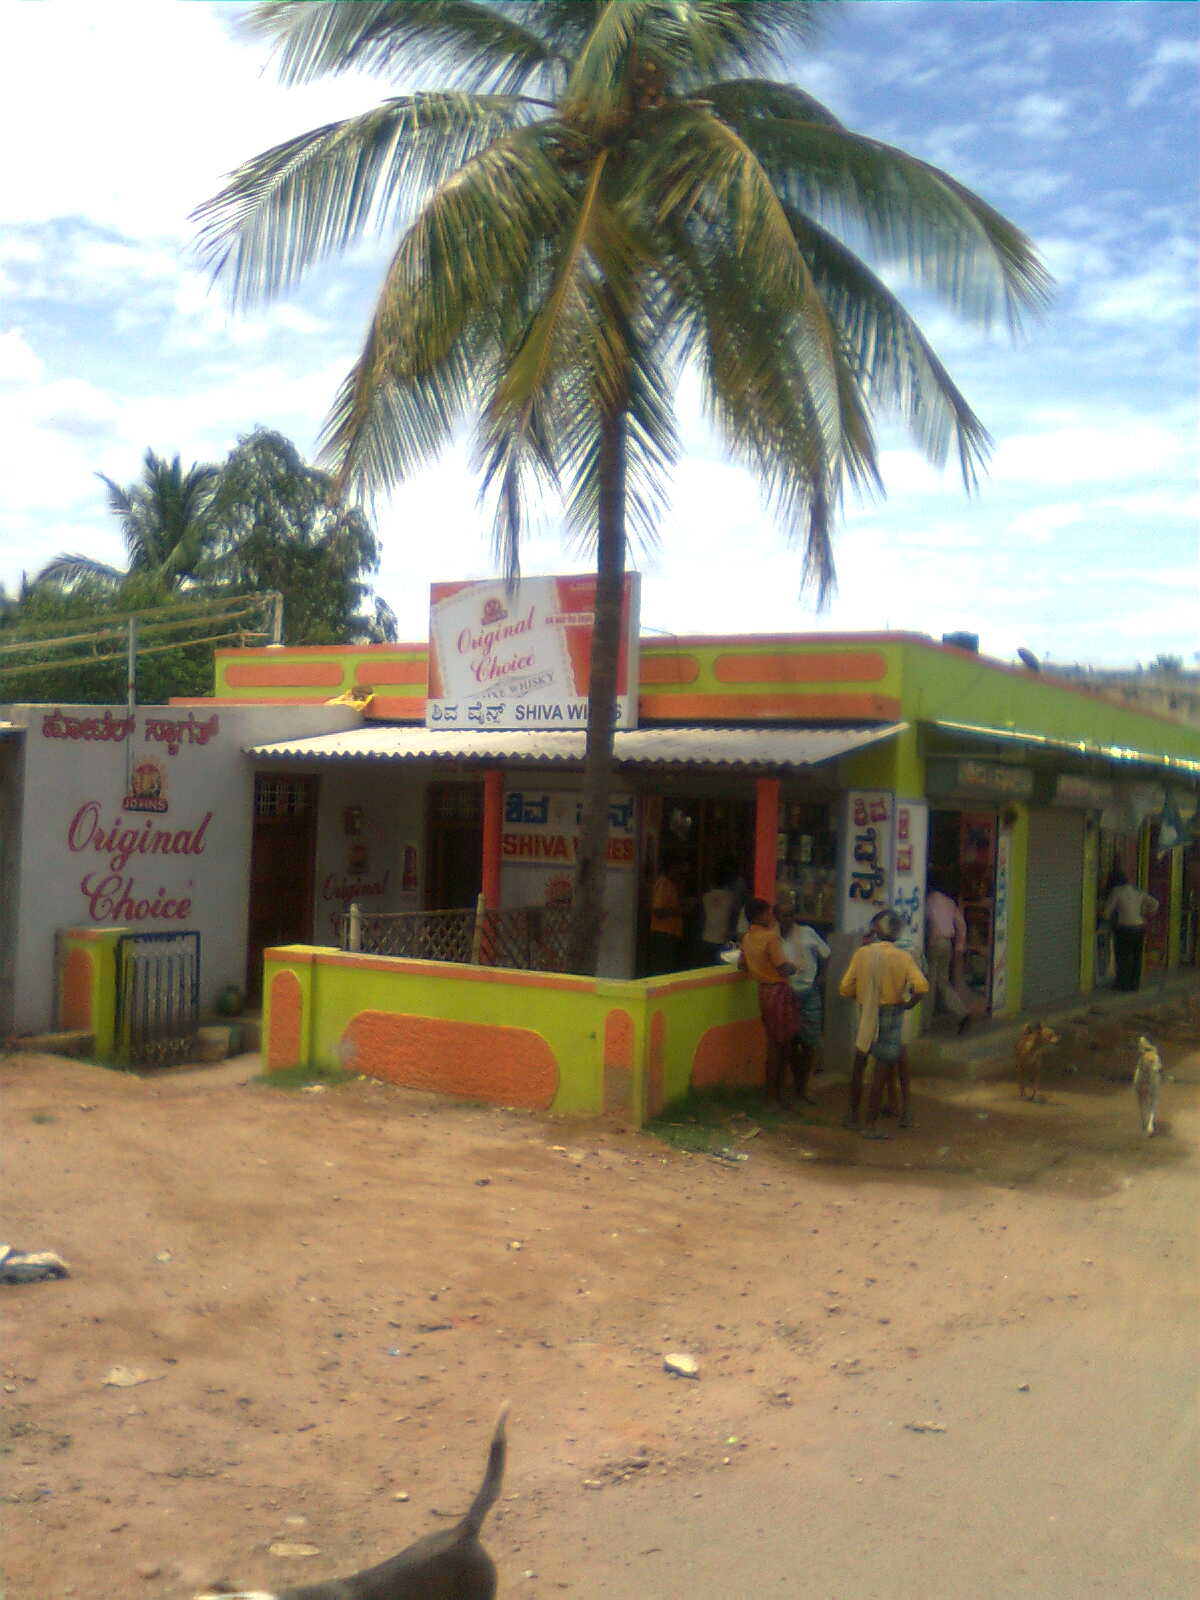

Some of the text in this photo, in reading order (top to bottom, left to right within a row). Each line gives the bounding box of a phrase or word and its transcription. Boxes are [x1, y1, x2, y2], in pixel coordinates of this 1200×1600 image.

[457, 605, 535, 658] Original
[469, 655, 534, 682] Choice
[432, 703, 459, 721] ಶಿವ
[515, 704, 622, 720] SHIVA WIS
[68, 800, 213, 872] Original
[502, 833, 568, 858] SHIVA
[80, 871, 193, 921] Choice
